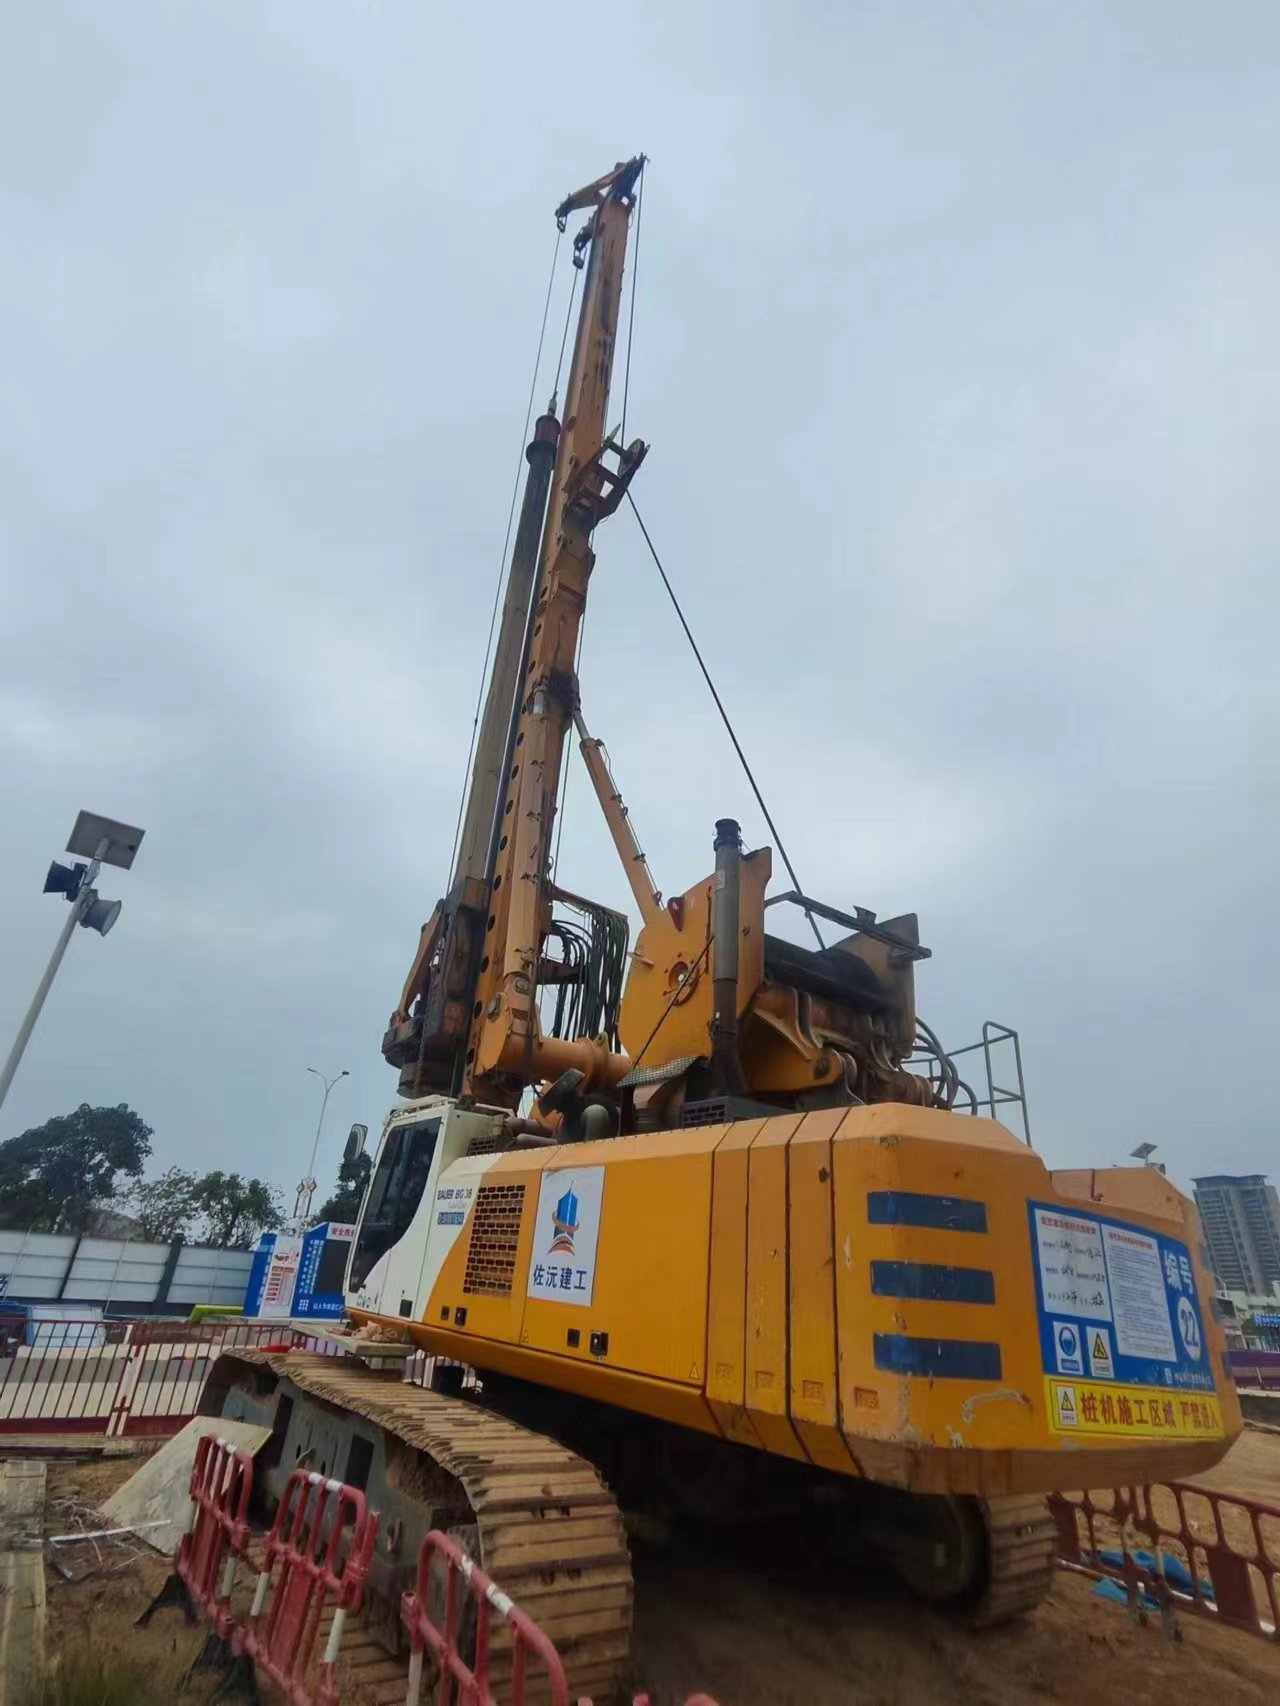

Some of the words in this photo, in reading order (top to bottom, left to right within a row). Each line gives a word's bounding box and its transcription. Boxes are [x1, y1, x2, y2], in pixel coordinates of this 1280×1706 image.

[437, 1189, 454, 1201] BAUER
[454, 1188, 465, 1200] BG
[533, 1263, 587, 1291] 佐沅建工
[1080, 1391, 1177, 1429] 桩机施工区域
